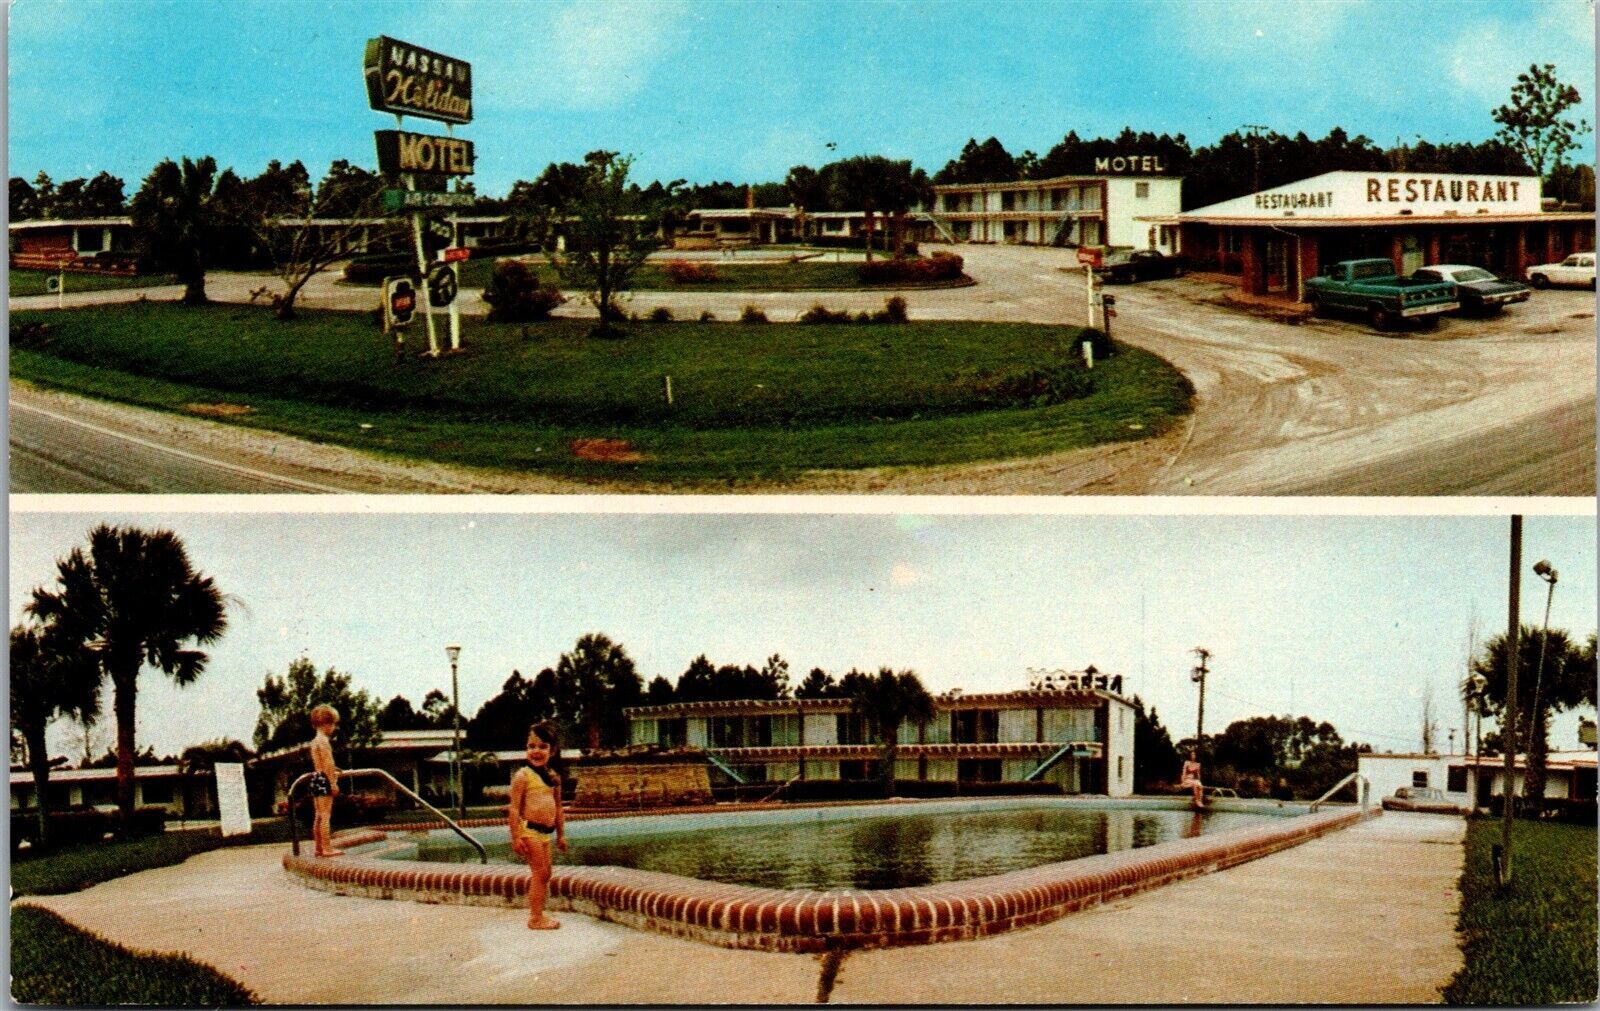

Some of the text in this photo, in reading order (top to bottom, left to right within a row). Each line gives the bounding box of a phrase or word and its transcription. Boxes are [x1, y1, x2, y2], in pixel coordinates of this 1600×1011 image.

[399, 133, 473, 174] MOTEL
[1095, 155, 1164, 173] MOTEL
[1256, 191, 1333, 209] RESTAURANT
[1367, 178, 1520, 202] RESTAURANT
